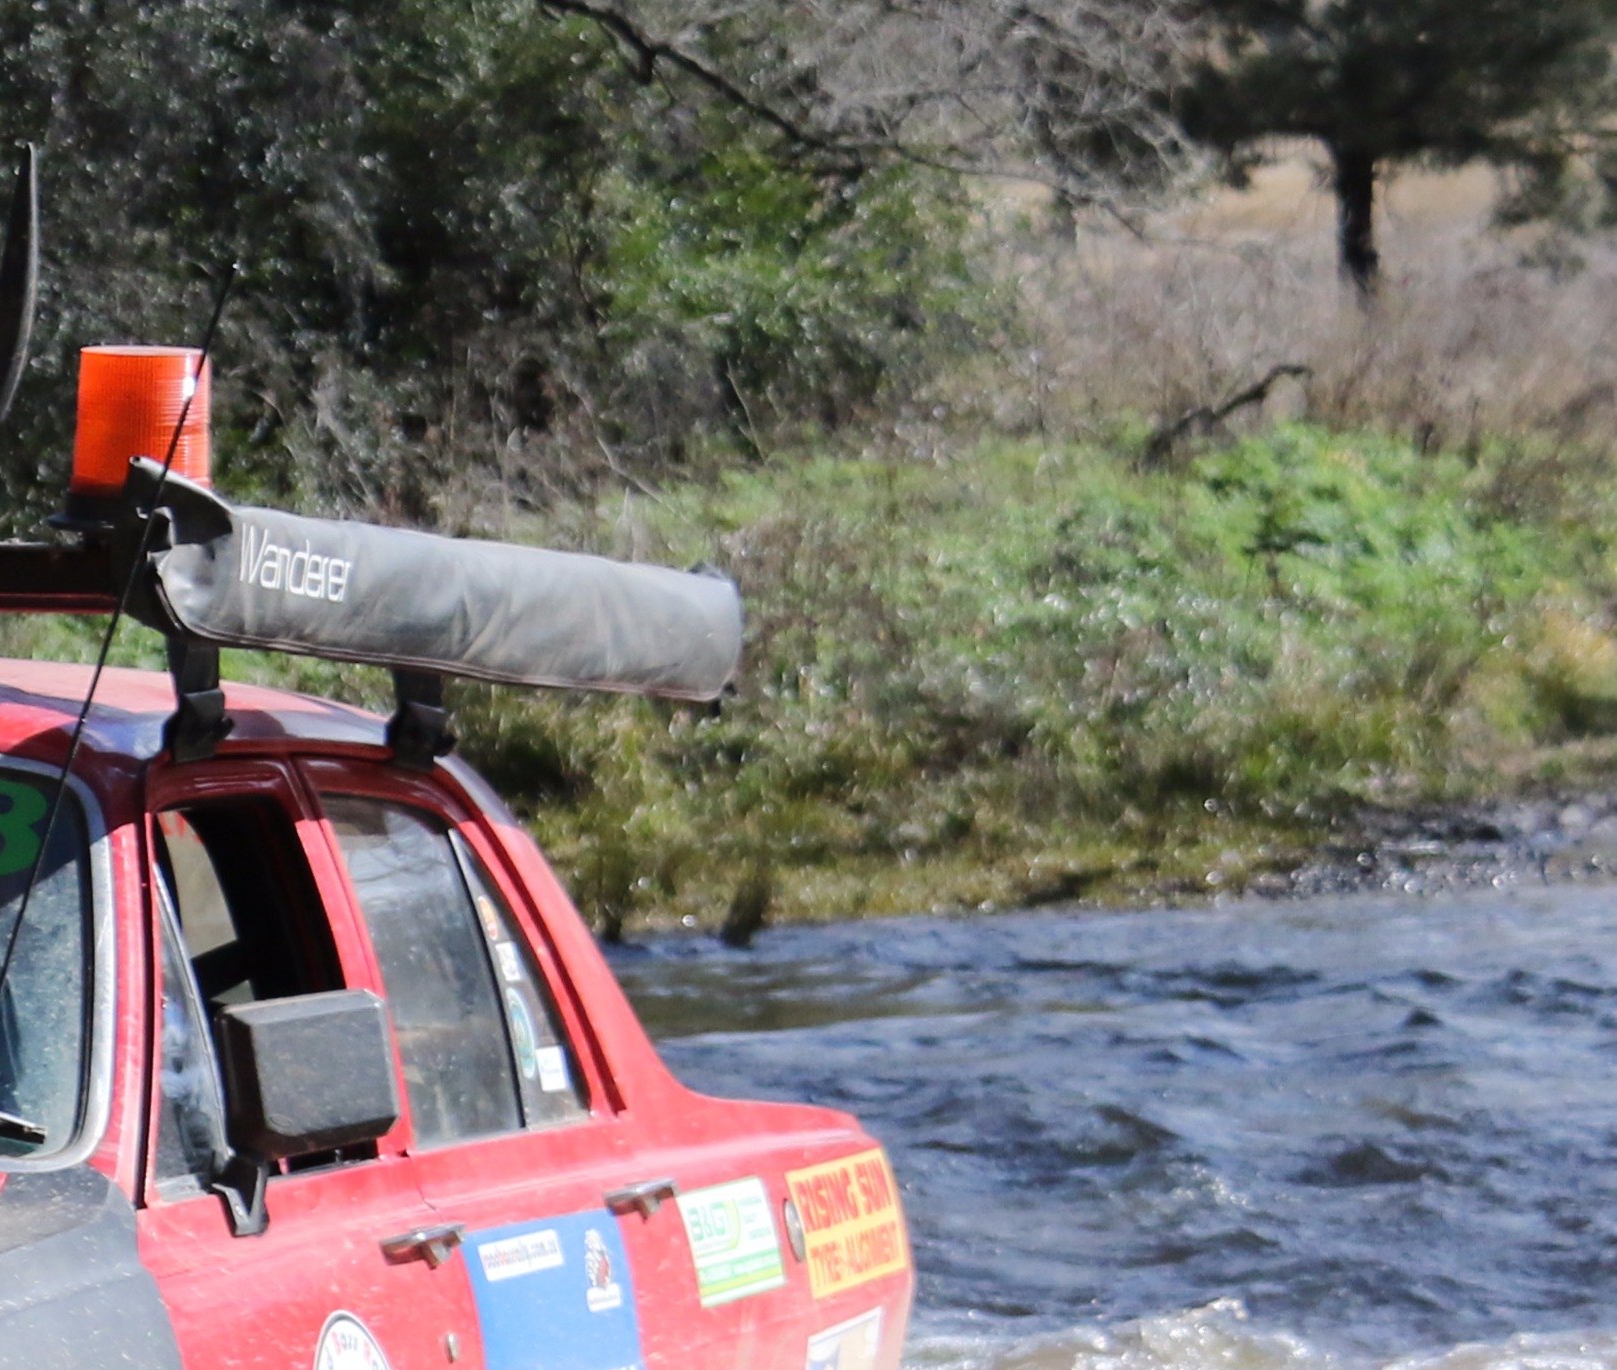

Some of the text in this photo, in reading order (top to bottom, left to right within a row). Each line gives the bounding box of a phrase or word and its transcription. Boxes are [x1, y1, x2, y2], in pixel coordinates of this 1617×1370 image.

[237, 522, 353, 603] Wanderer
[793, 1158, 892, 1232] RISING SUN
